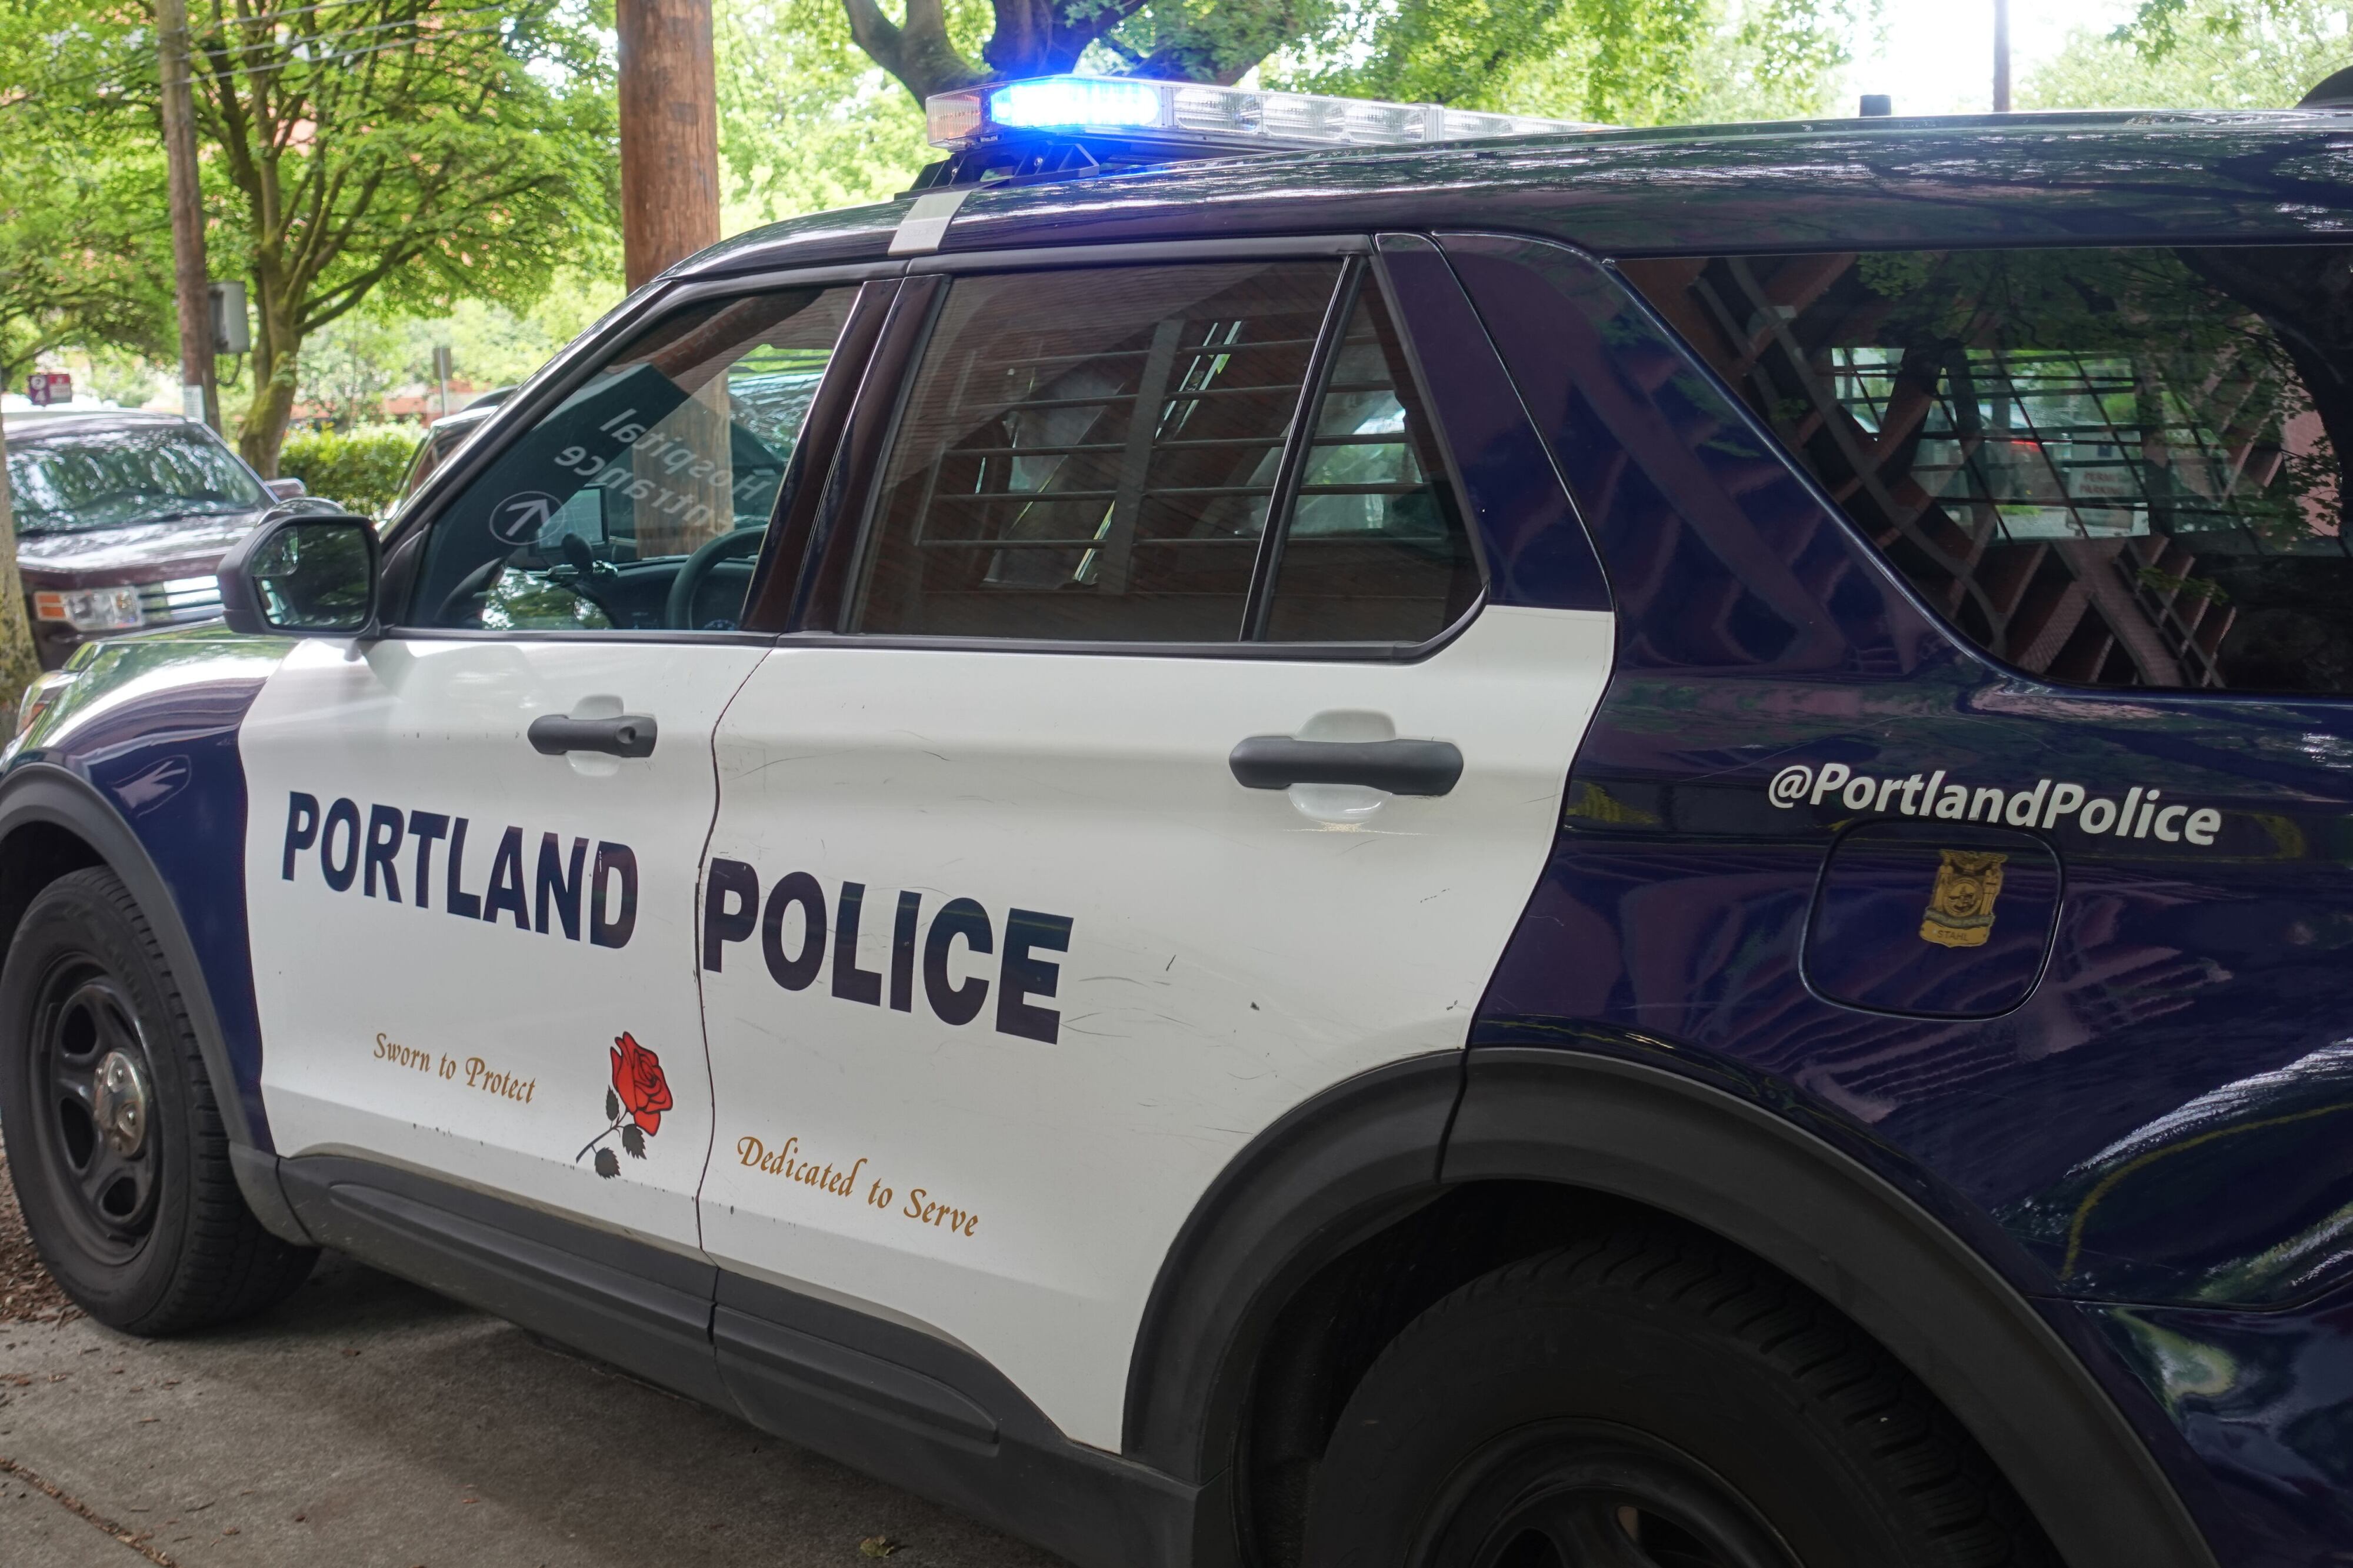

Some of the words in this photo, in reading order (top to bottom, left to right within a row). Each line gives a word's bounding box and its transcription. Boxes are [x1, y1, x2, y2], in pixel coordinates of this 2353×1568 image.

[1768, 762, 2221, 846] @PortlandPolice
[282, 791, 638, 949] PORTLAND
[703, 857, 1074, 1045] POLICE
[1937, 930, 1968, 942] STAHL
[374, 1033, 432, 1072] Sworn
[438, 1052, 456, 1080] to
[465, 1057, 536, 1104] Protect
[737, 1136, 868, 1197] Dedicated
[868, 1178, 893, 1209] to
[904, 1189, 978, 1237] Serve
